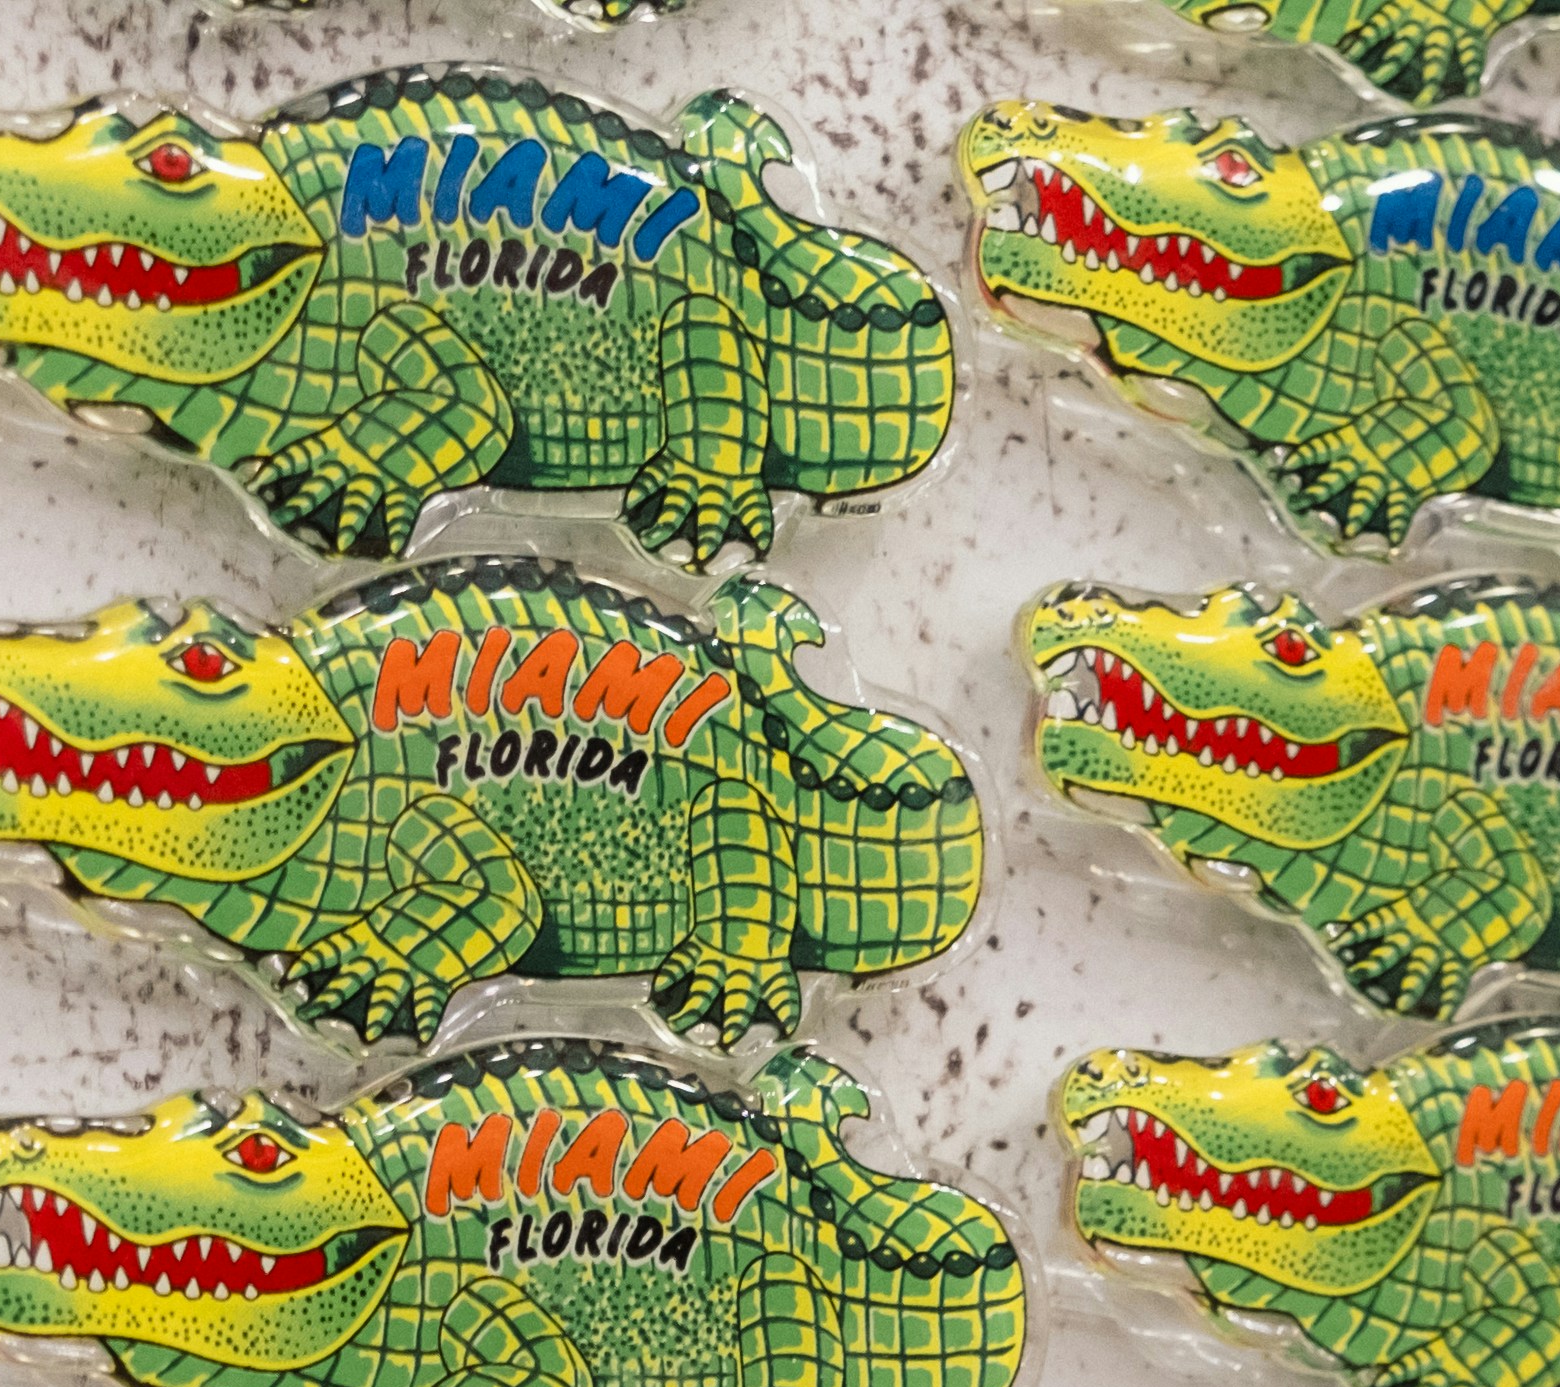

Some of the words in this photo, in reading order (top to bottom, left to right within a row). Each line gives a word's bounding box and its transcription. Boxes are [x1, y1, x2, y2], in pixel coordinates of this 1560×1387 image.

[341, 135, 698, 260] MIAMI
[406, 238, 618, 308] FLORIDA
[374, 628, 730, 746] MIAMI
[437, 729, 648, 795] FLORIDA
[427, 1110, 774, 1221] MIAMI
[488, 1208, 698, 1272] FLORIDA
